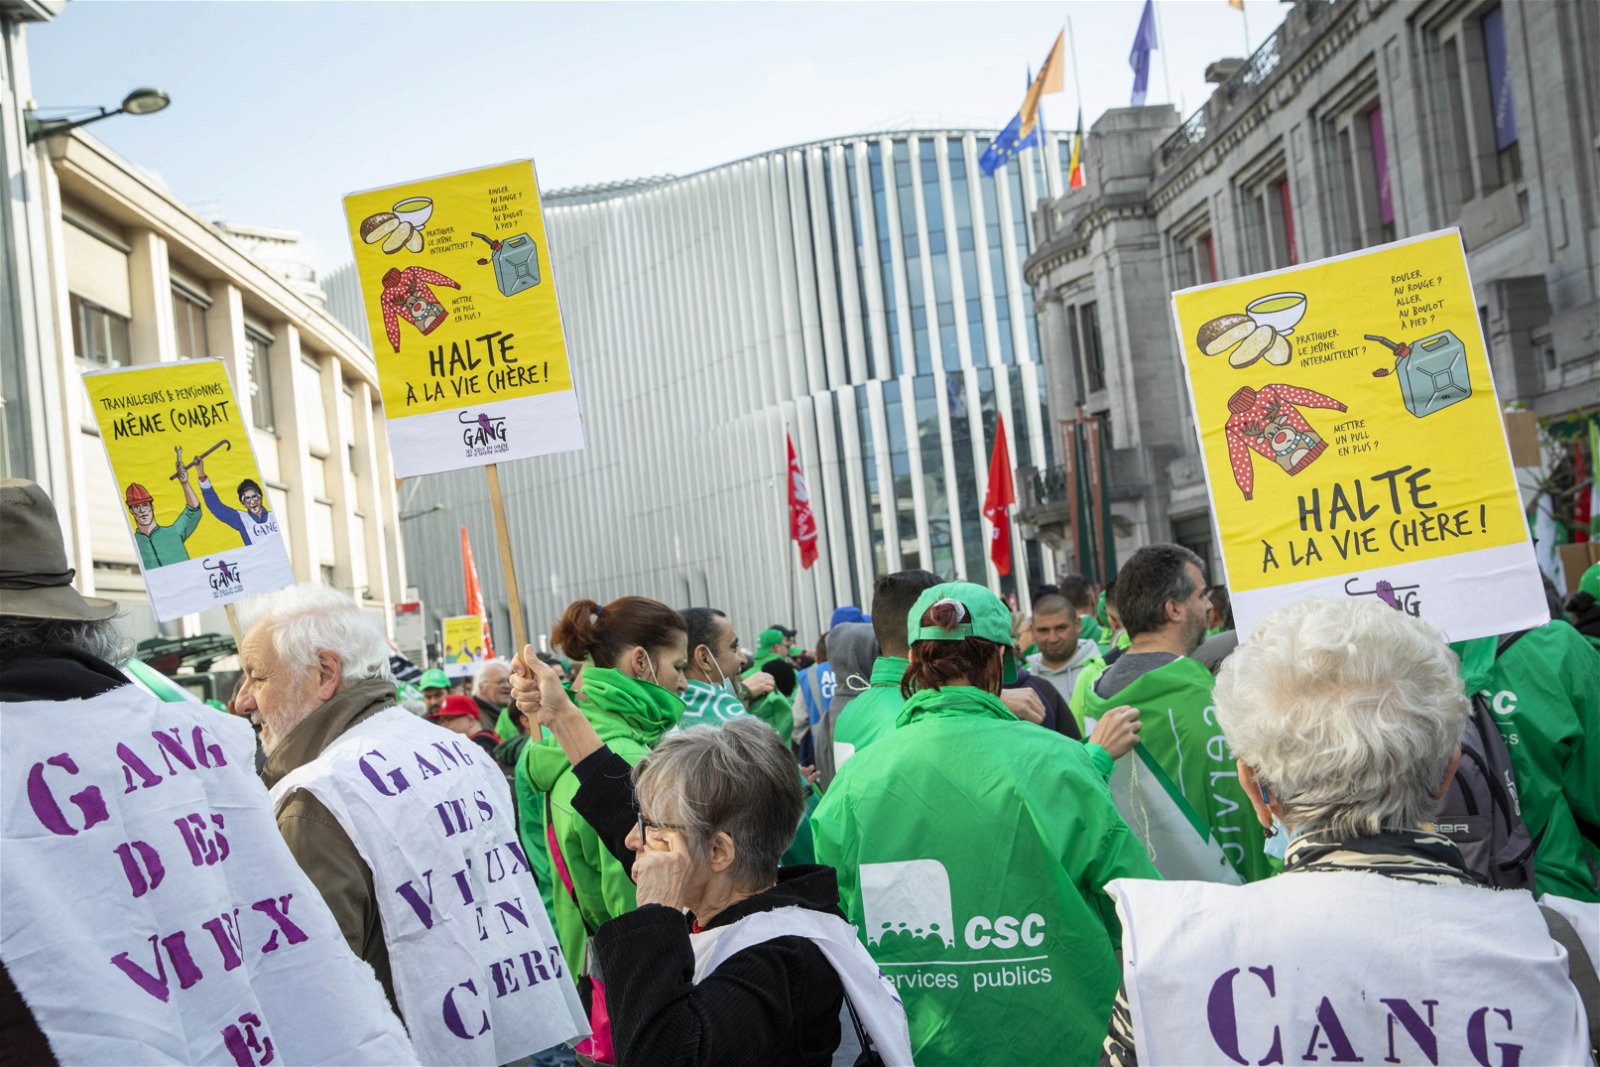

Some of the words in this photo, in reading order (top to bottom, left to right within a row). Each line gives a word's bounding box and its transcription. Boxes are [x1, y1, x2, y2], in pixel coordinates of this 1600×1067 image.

[499, 193, 517, 203] ROUGE
[492, 204, 509, 214] ALLER
[494, 214, 501, 222] AU
[502, 209, 524, 221] BOULOT
[501, 221, 513, 230] PIED
[430, 240, 469, 255] INTERMITTENT
[1391, 269, 1423, 284] ROULER
[1394, 285, 1405, 295] AU
[1407, 279, 1435, 293] ROUGE
[451, 295, 473, 306] METTRE
[1396, 294, 1422, 307] ALLER
[452, 306, 461, 314] UN
[462, 304, 475, 312] PULL
[1399, 308, 1410, 319] AU
[1412, 299, 1445, 316] BOULOT
[454, 314, 463, 323] EN
[463, 312, 477, 321] PLUS
[1400, 319, 1407, 330] À
[1408, 316, 1428, 329] PIED
[1296, 328, 1340, 345] PRATIQUER
[428, 330, 518, 378] HALTE
[1298, 346, 1308, 356] LE
[1300, 347, 1360, 368] INTERMITTENT
[406, 381, 418, 406] À
[423, 380, 445, 402] LA
[450, 375, 481, 398] VIE
[487, 364, 540, 394] CHÈRE
[166, 389, 174, 402] &
[113, 412, 166, 440] MÊME
[170, 400, 229, 433] COMBAT
[1333, 419, 1366, 433] METTRE
[463, 421, 507, 449] GANG
[1335, 435, 1349, 445] UN
[1351, 431, 1370, 443] PULL
[1338, 447, 1350, 457] EN
[1351, 443, 1372, 455] PLUS
[1297, 464, 1438, 532] HALTE
[253, 521, 279, 537] GANG
[1261, 539, 1280, 573] À
[1289, 537, 1323, 567] LA
[1331, 527, 1380, 561] VIE
[1389, 509, 1473, 552] CHÈRE
[209, 566, 242, 591] GANG
[358, 740, 475, 797] GANG
[27, 725, 228, 836] GANG
[973, 966, 1053, 992] publics
